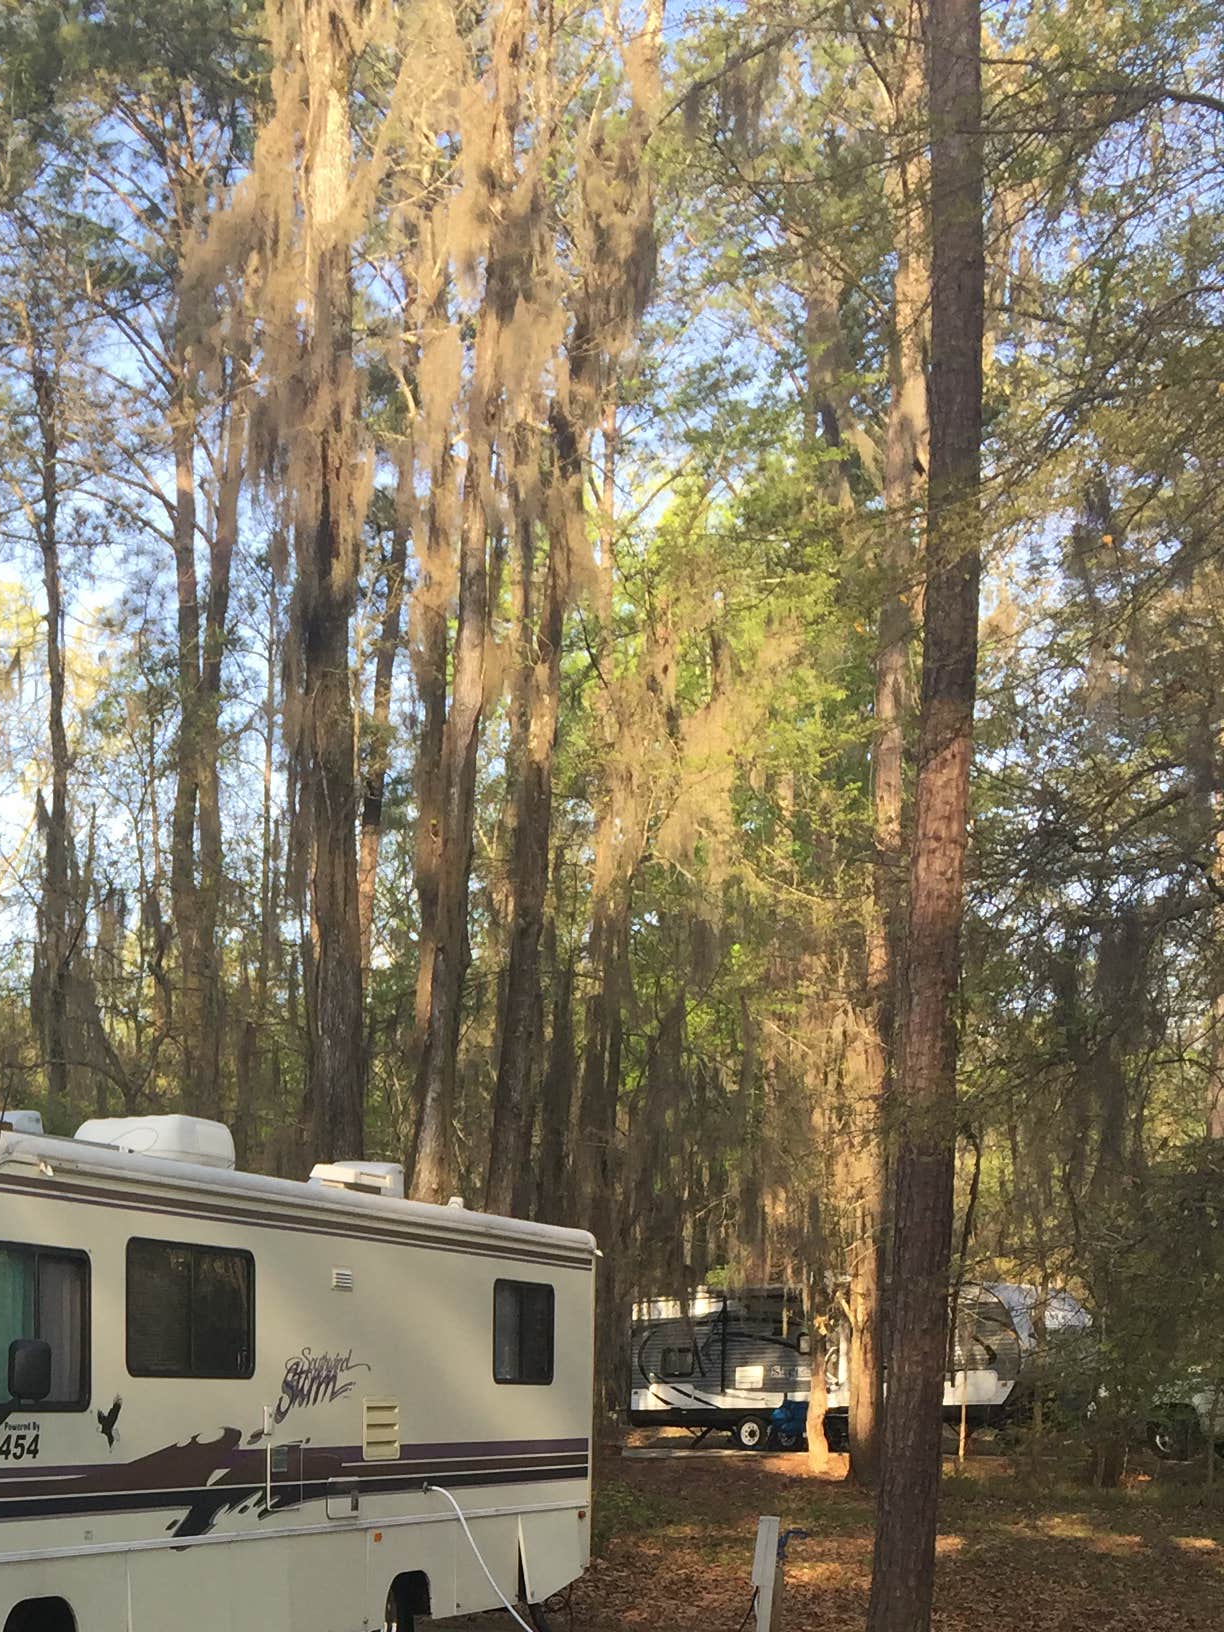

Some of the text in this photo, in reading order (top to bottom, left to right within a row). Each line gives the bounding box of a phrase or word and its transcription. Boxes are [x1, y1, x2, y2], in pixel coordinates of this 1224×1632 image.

[274, 1357, 356, 1425] Storm
[4, 1421, 41, 1433] Powered By
